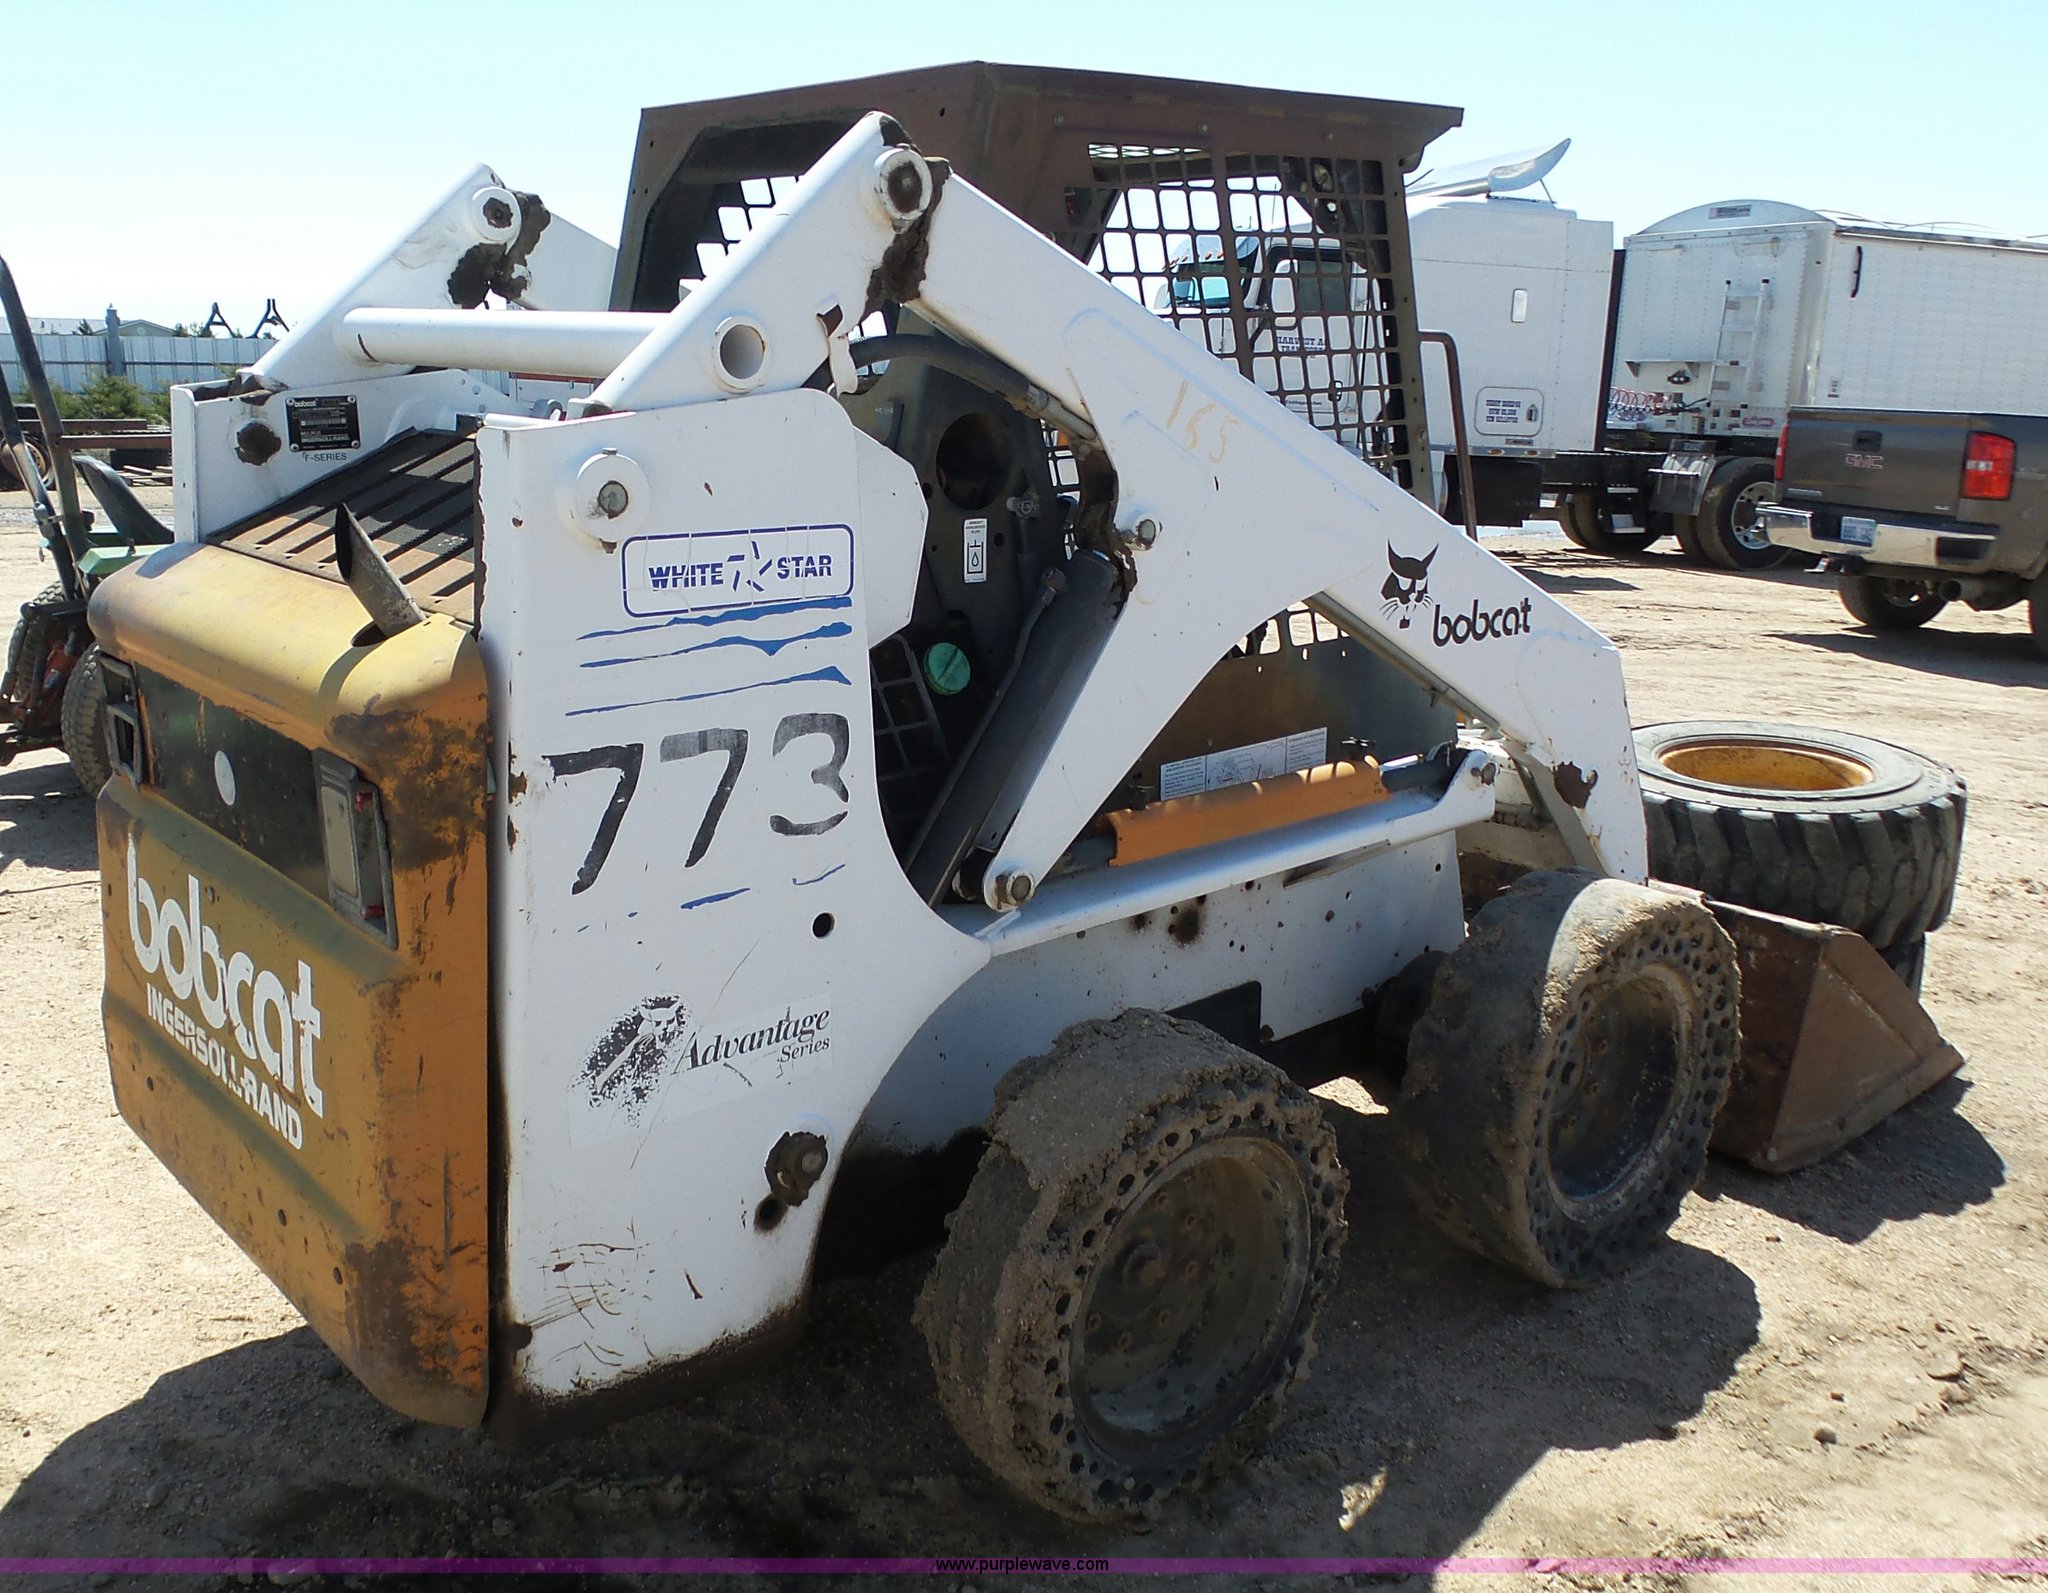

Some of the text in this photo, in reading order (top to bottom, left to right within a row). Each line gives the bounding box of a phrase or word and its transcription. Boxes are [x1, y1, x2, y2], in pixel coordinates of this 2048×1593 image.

[1166, 379, 1238, 464] 165
[303, 451, 348, 462] F-SERIES
[1845, 453, 1884, 470] GMC
[649, 554, 832, 590] WHITE STAR
[1432, 597, 1532, 647] bobcat
[540, 712, 849, 896] 773
[127, 832, 324, 1119] bobcat
[671, 1009, 830, 1076] Advantage
[776, 1034, 830, 1064] Series
